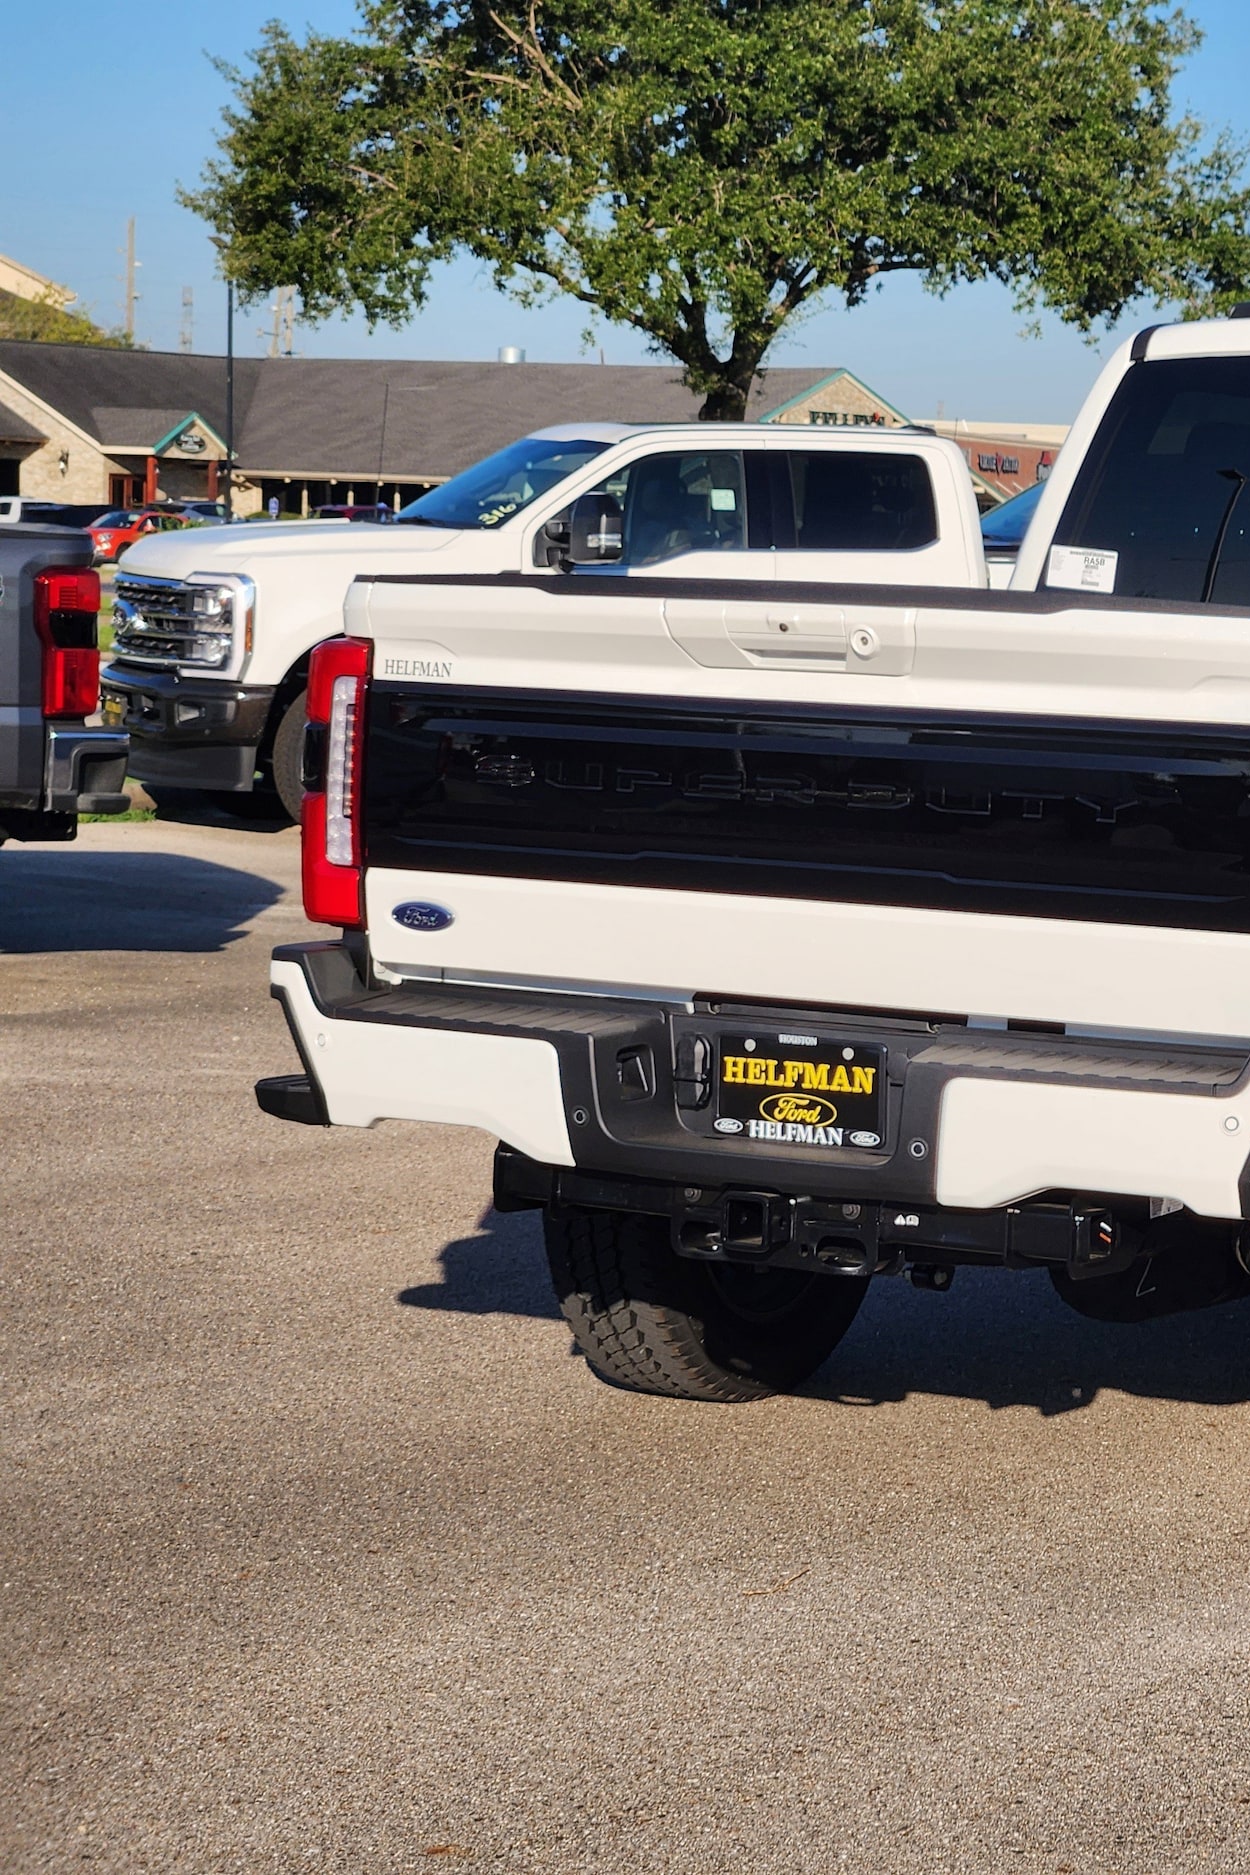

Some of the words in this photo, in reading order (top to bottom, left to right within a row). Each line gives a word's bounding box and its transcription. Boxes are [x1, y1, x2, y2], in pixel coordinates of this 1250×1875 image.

[478, 503, 517, 525] 316
[384, 658, 453, 678] HELFMAN
[403, 906, 439, 926] Ford
[778, 1033, 817, 1046] HOUSTON
[723, 1056, 876, 1094] HELFMAN
[773, 1096, 821, 1122] Ford
[749, 1119, 844, 1146] HELFMAN
